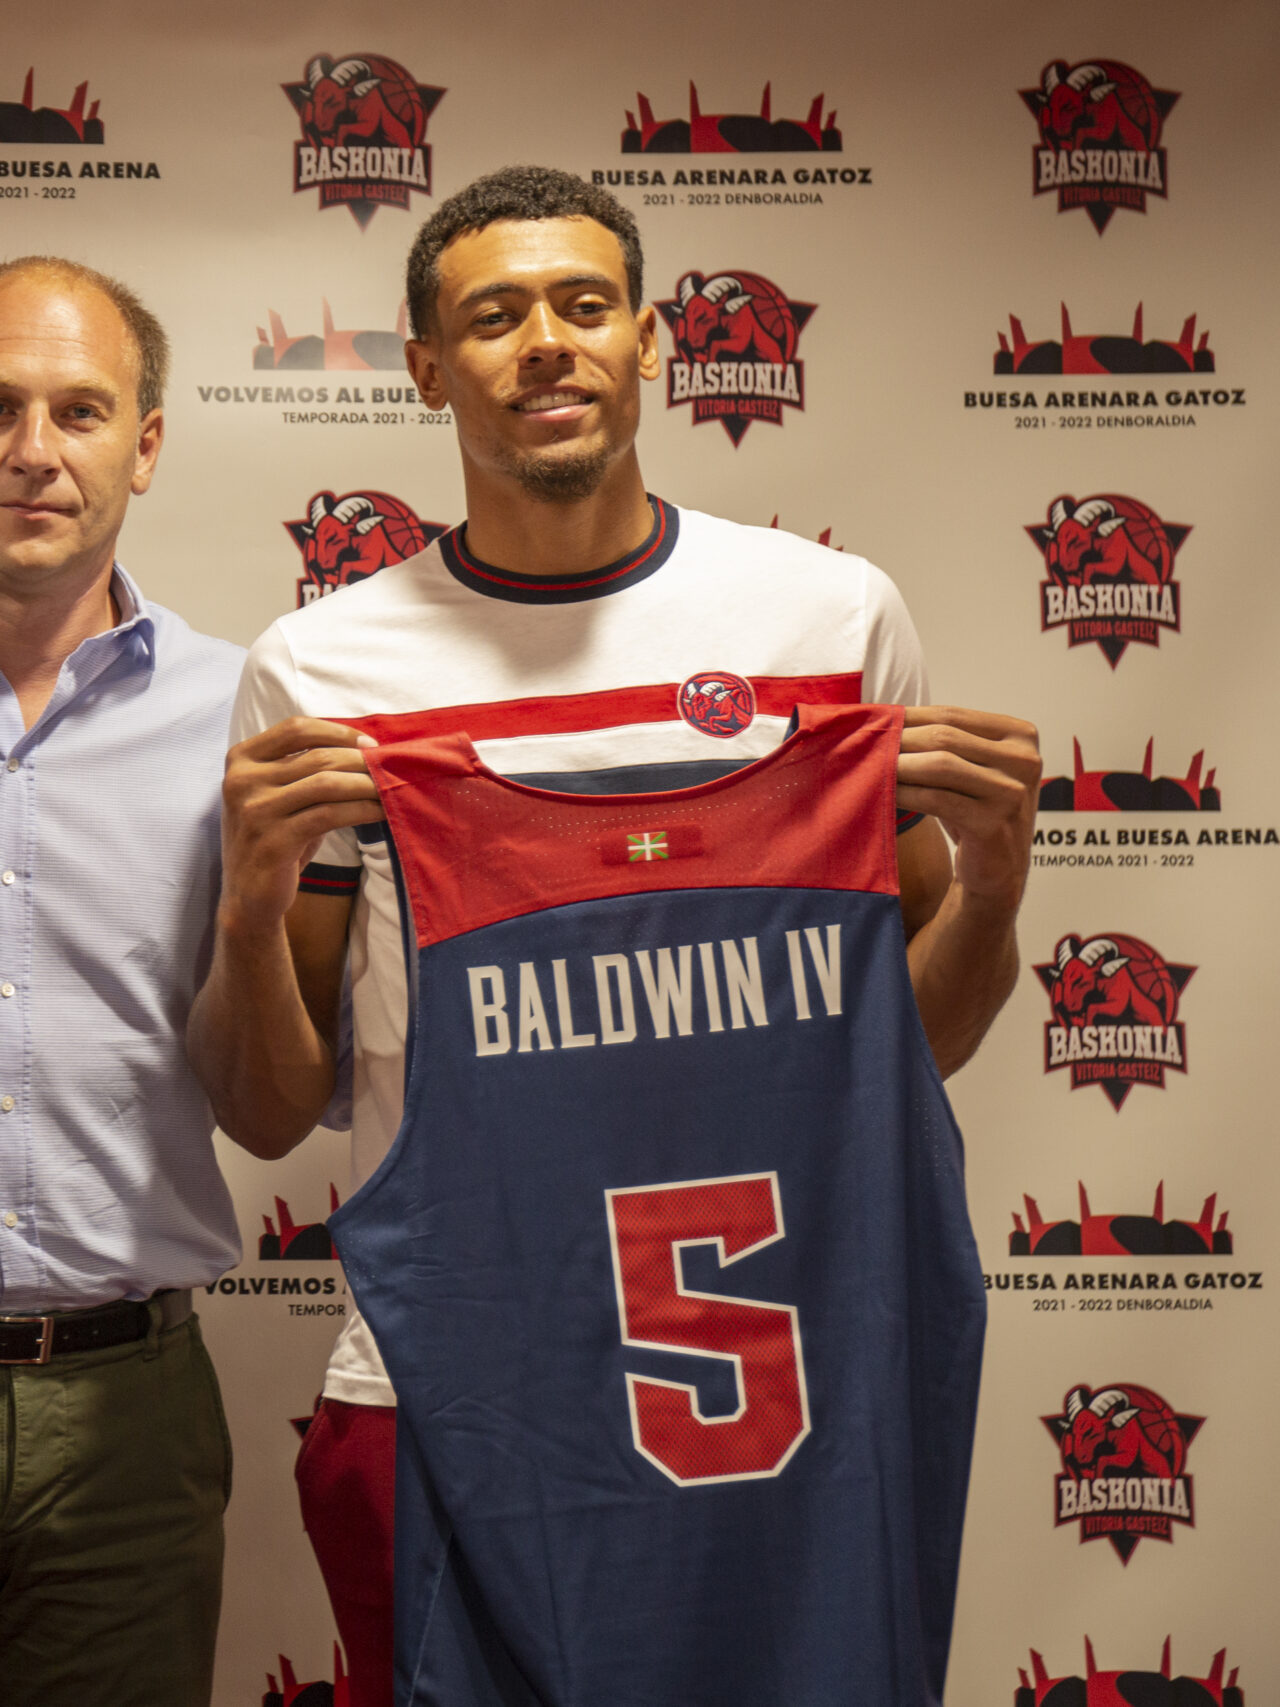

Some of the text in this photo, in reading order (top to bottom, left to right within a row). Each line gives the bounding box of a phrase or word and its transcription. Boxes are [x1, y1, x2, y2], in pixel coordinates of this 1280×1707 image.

[79, 162, 160, 179] ARENA
[300, 145, 428, 186] BASKONIA
[1038, 149, 1161, 189] BASKONIA
[591, 168, 872, 186] BUESA ARENARA GATOZ
[41, 187, 76, 199] 2022
[644, 194, 674, 205] 2021
[688, 194, 720, 205] 2022
[725, 193, 823, 204] DENBORALDIA
[674, 360, 798, 400] BASKONIA
[197, 386, 424, 403] VOLVEMOS AL BUE
[965, 390, 1245, 407] BUESA ARENARA GATOZ
[284, 412, 369, 424] TEMPORADA
[373, 413, 404, 424] 2021
[418, 413, 452, 424] 2022
[1015, 417, 1046, 428] 2021
[1059, 416, 1091, 428] 2022
[1097, 415, 1195, 427] DENBORALDIA
[1045, 584, 1176, 623] BASKONIA
[1084, 830, 1110, 845] AL
[1117, 830, 1189, 845] BUESA
[1197, 830, 1279, 844] ARENA
[1033, 856, 1113, 867] TEMPORADA
[1118, 855, 1147, 866] 2021
[1161, 855, 1194, 866] 2022
[467, 924, 842, 1057] BALDWIN IV
[1049, 1025, 1182, 1064] BASKONIA
[205, 1278, 336, 1294] VOLVEMOS
[984, 1273, 1262, 1291] BUESA ARENARA GATOZ
[1033, 1299, 1065, 1311] 2021
[1079, 1299, 1112, 1311] 2022
[1117, 1299, 1213, 1310] DENBORALDIA
[604, 1170, 811, 1487] 5
[1059, 1478, 1189, 1518] BASKONIA
